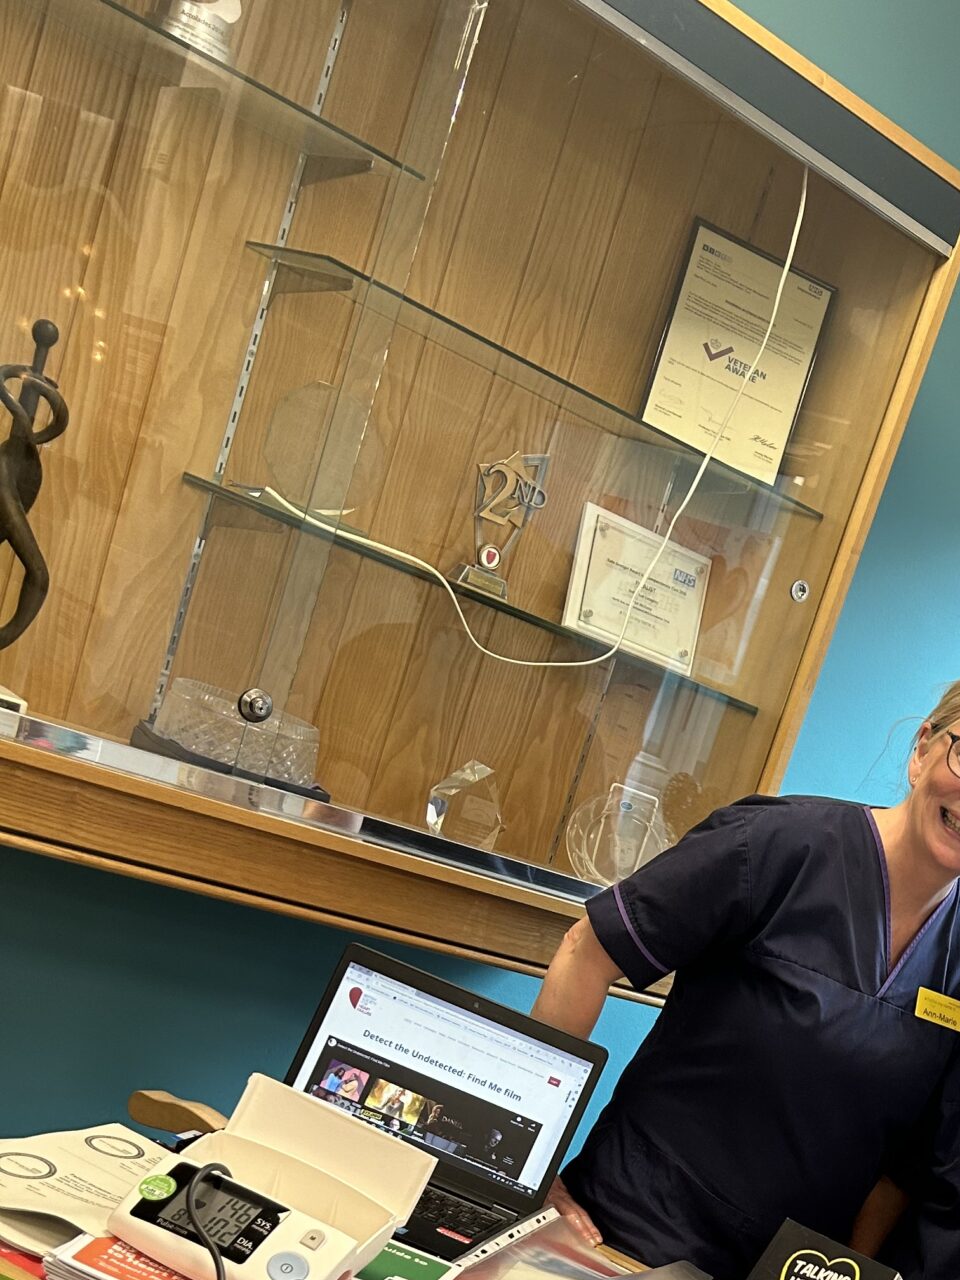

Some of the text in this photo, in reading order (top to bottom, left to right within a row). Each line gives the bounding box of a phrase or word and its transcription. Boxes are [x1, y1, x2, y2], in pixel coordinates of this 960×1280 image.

[673, 569, 696, 587] NHS
[921, 1007, 959, 1027] Ann-Marie
[361, 1028, 523, 1103] Detect the Undetected: Find Me film
[217, 1194, 259, 1228] 146
[201, 1213, 242, 1247] 102
[254, 1215, 274, 1232] SYS.
[109, 1242, 136, 1260] Big
[236, 1234, 256, 1252] DIA.
[105, 1247, 170, 1279] to Heart
[412, 1256, 429, 1267] to
